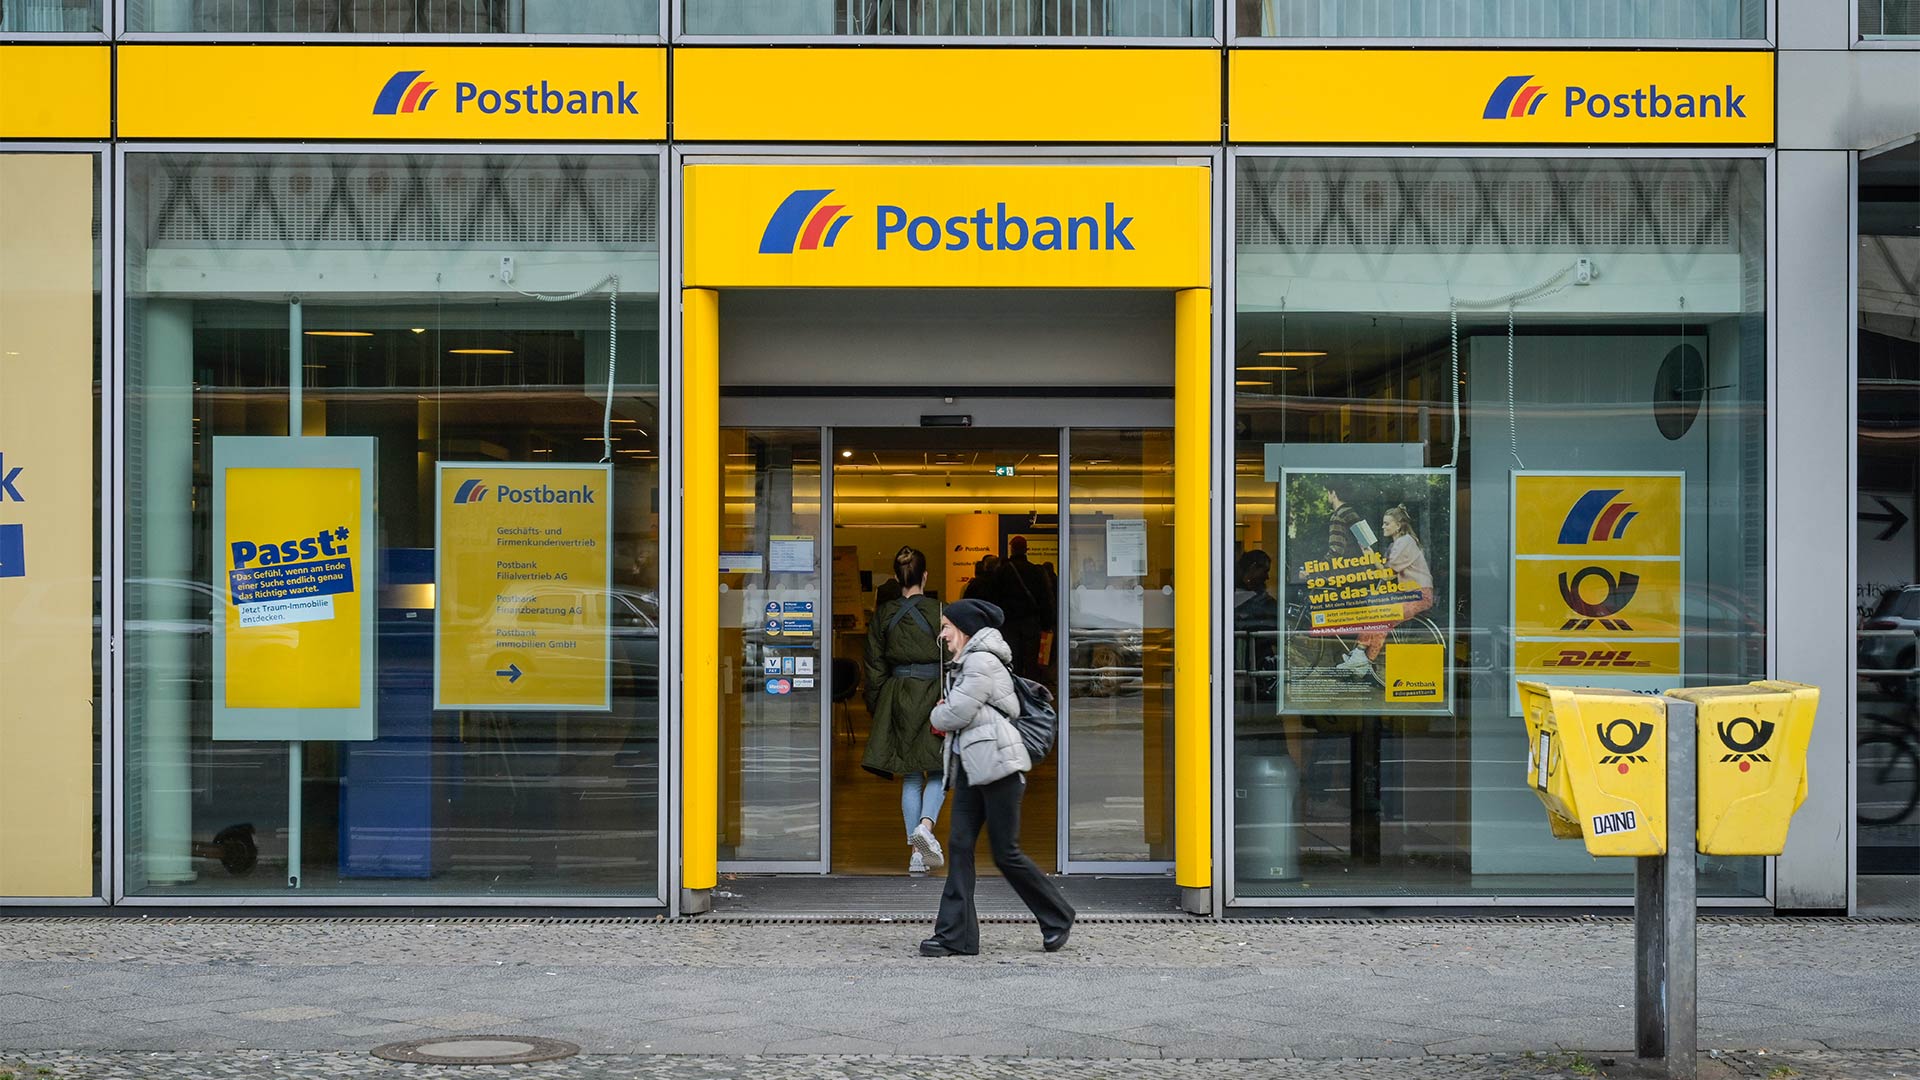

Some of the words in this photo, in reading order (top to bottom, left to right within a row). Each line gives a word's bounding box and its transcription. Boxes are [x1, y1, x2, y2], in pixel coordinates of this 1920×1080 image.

[456, 80, 639, 115] Postbank
[1565, 84, 1747, 119] Postbank
[876, 202, 1136, 251] Postbank
[497, 485, 595, 503] Postbank
[496, 527, 542, 536] Geschäfts-
[545, 527, 562, 536] und
[496, 538, 596, 548] Firmenkundenvertrieb
[496, 560, 537, 569] Postbank
[1304, 559, 1330, 573] Ein
[1332, 551, 1387, 570] Kredit,
[254, 568, 284, 580] Gefühl,
[286, 567, 309, 576] wenn
[310, 565, 324, 573] am
[326, 562, 346, 571] Ende
[496, 572, 552, 581] Filialvertrieb
[554, 572, 568, 581] AG
[1306, 577, 1326, 589] so
[1328, 567, 1394, 588] spontan
[238, 582, 259, 591] einer
[260, 579, 285, 589] Suche
[286, 574, 316, 586] endlich
[317, 572, 344, 584] genau
[239, 591, 253, 600] das
[255, 587, 288, 600] Richtige
[289, 585, 320, 595] wartet.
[496, 594, 537, 603] Postbank
[1309, 590, 1338, 605] wie
[1340, 586, 1368, 600] das
[1369, 580, 1421, 597] Leben.
[242, 605, 261, 615] Jetzt
[262, 600, 329, 613] Traum-Immobilie
[496, 606, 566, 616] Finanzberatung
[569, 606, 583, 615] AG
[242, 613, 286, 624] entdecken.
[496, 628, 537, 637] Postbank
[496, 640, 546, 649] Immobilien
[549, 640, 577, 649] GmbH
[769, 659, 777, 667] V
[1557, 650, 1637, 667] DHL
